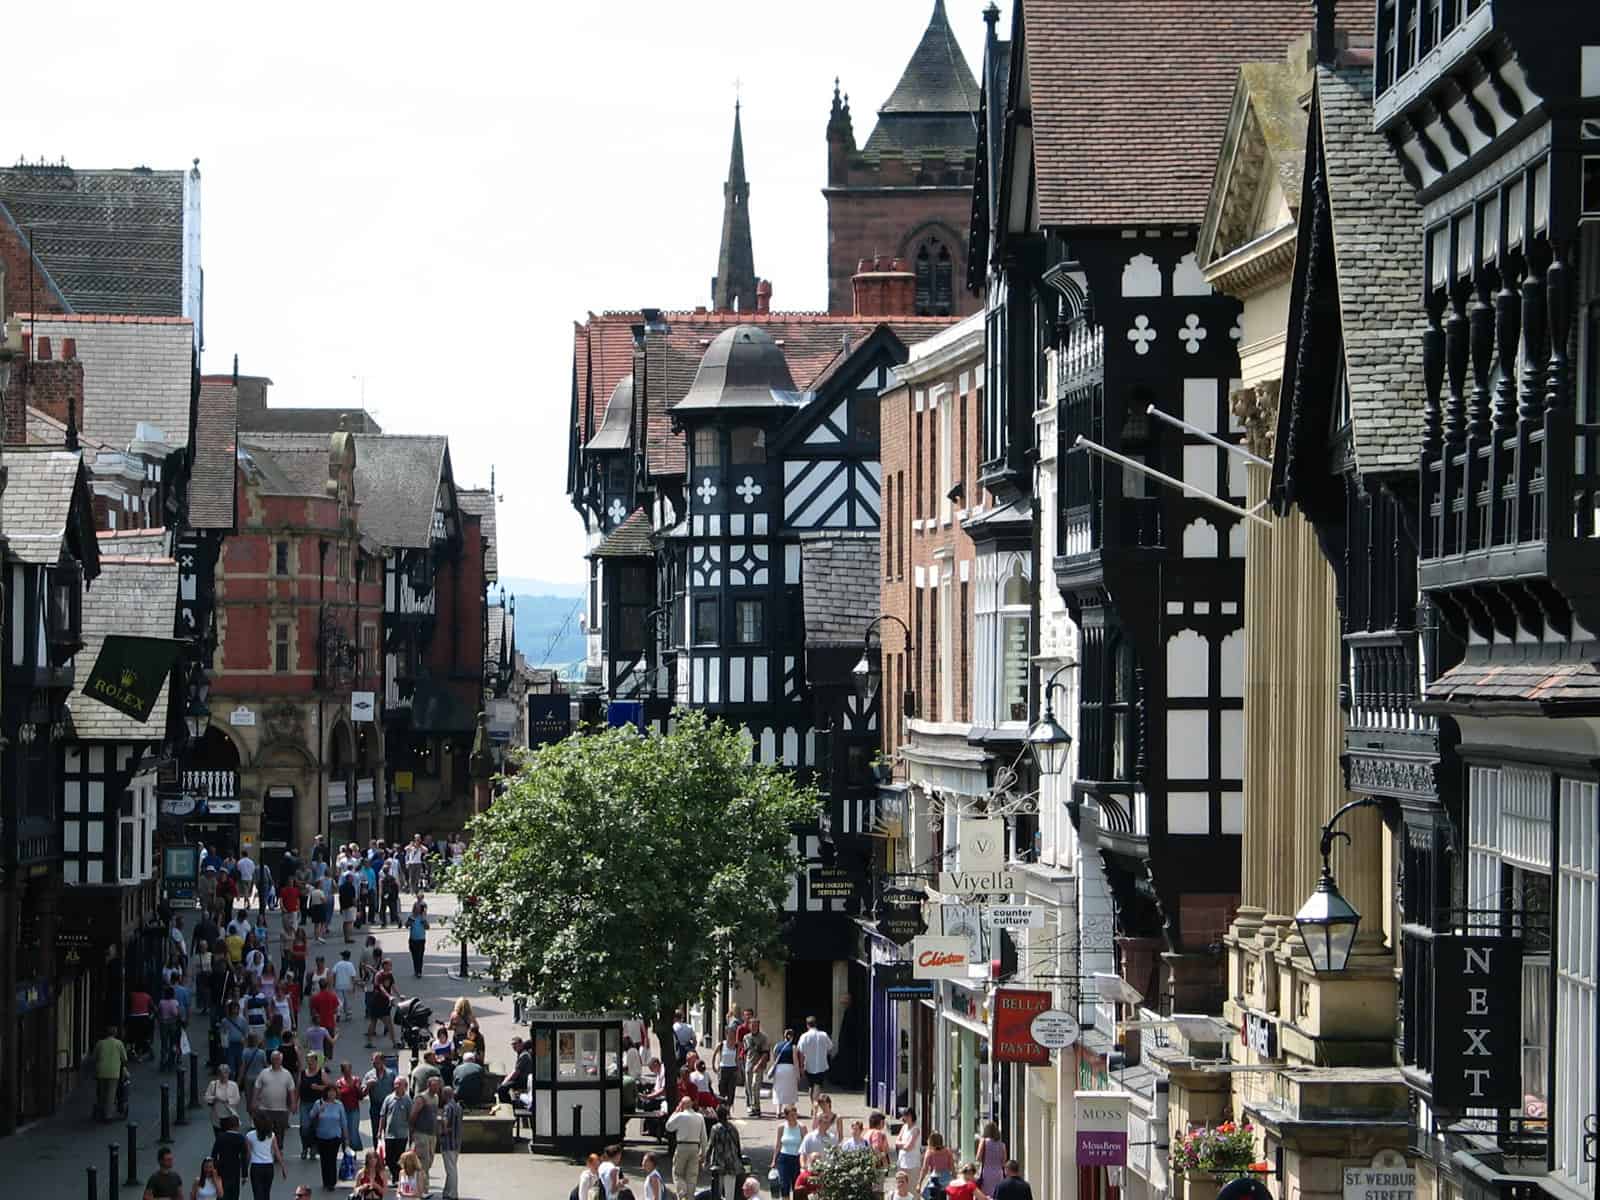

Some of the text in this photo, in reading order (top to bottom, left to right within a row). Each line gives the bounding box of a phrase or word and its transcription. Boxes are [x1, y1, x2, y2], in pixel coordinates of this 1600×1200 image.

[95, 680, 146, 711] ROLEX
[975, 839, 988, 853] V
[950, 872, 1014, 890] Viyella
[993, 917, 1030, 925] culture
[918, 950, 966, 968] Clinton
[1001, 998, 1045, 1010] BELLA
[1463, 947, 1493, 1097] NEXT
[1000, 1042, 1041, 1055] PASTA
[1082, 1109, 1122, 1120] MOSS
[1365, 1173, 1416, 1186] WERBUR
[1365, 1190, 1414, 1200] STREET
